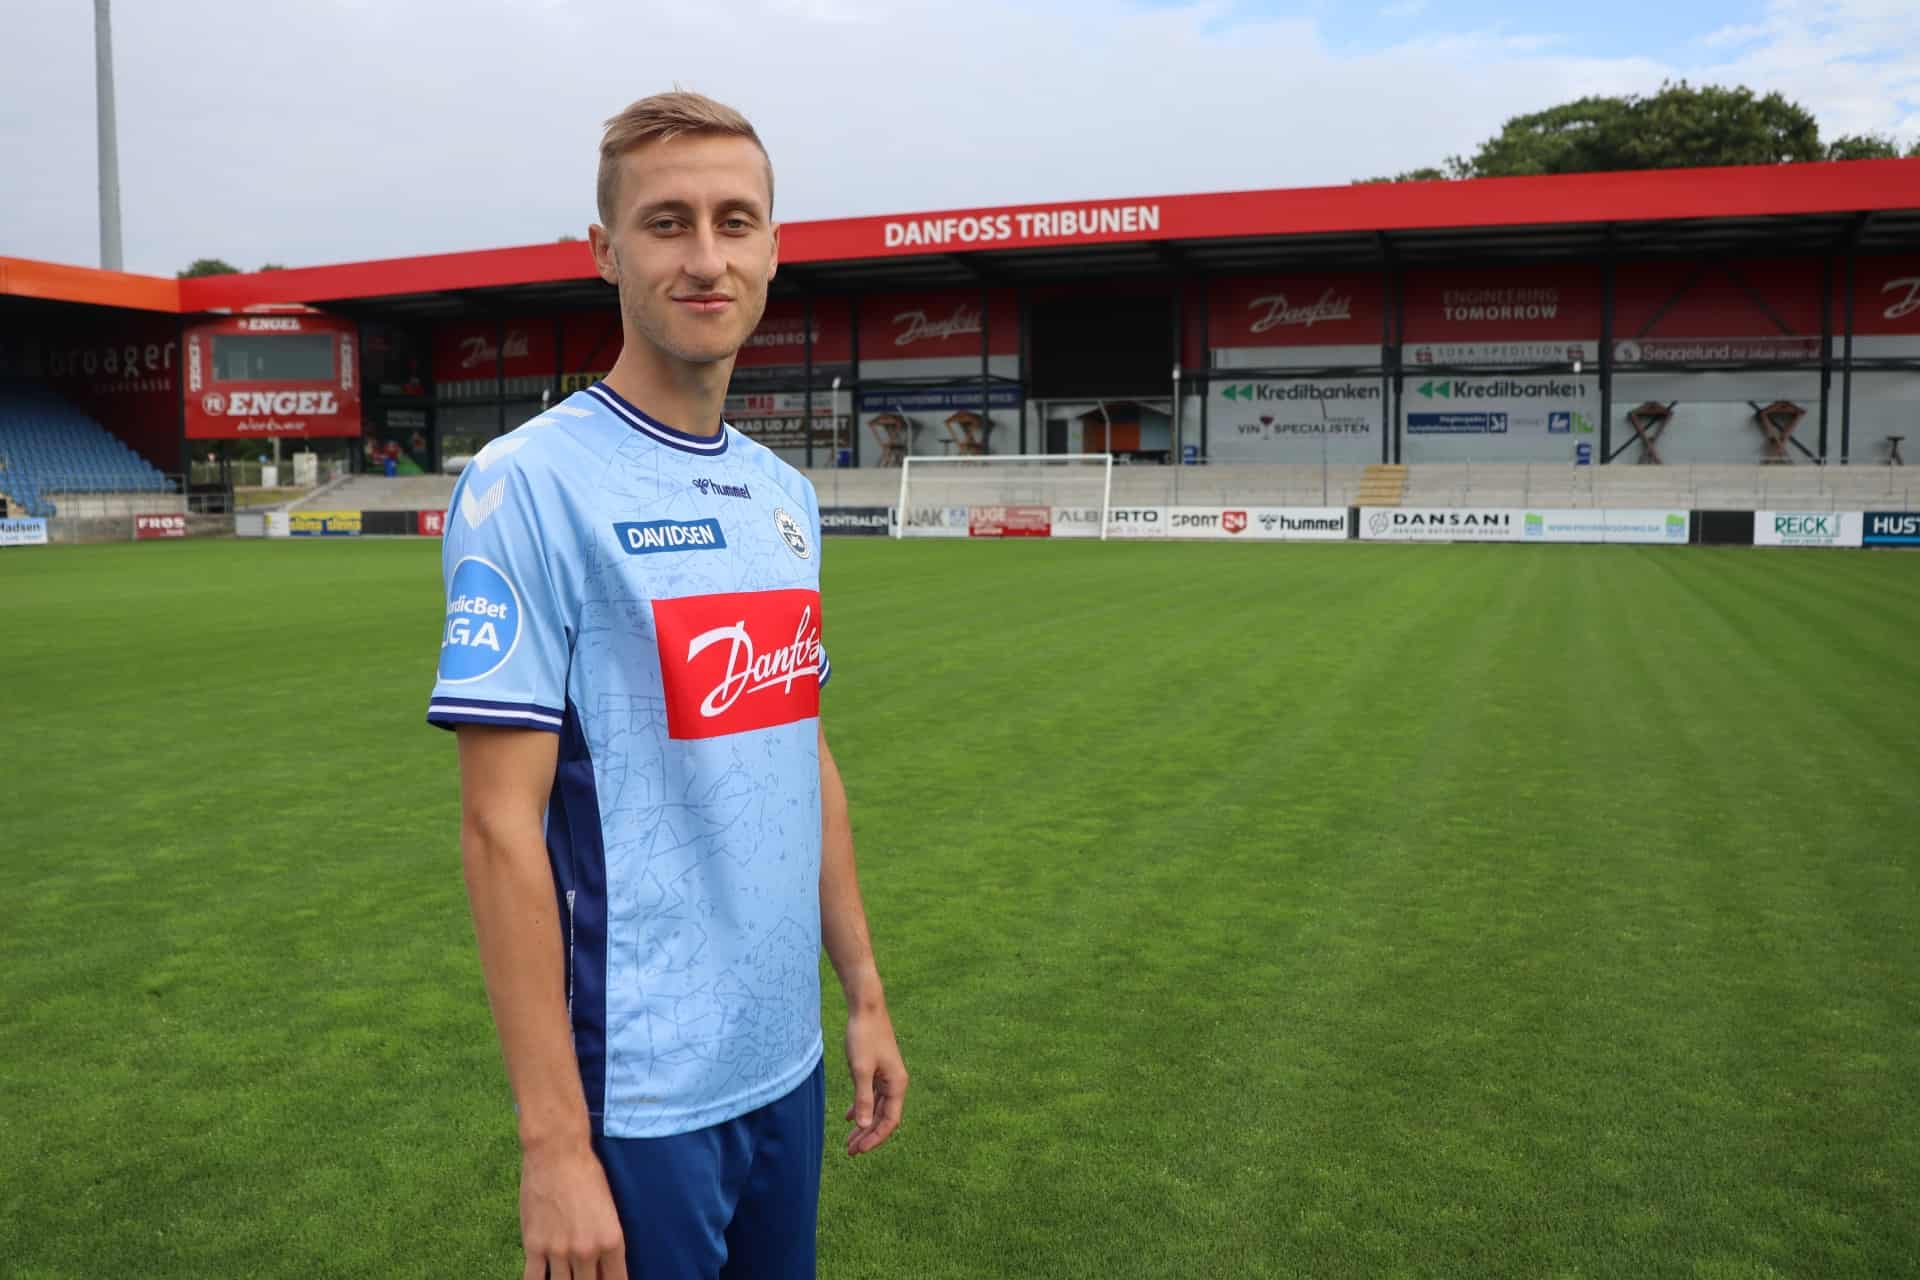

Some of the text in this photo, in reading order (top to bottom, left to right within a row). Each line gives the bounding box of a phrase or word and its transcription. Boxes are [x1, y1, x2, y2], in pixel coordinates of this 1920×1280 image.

[885, 205, 1160, 247] DANFOSS TRIBUNEN
[1442, 304, 1558, 320] TOMORROW
[248, 317, 301, 331] ENGEL
[1256, 383, 1380, 400] Kreditbanken
[1453, 379, 1585, 399] Kreditbanken
[227, 392, 338, 416] ENGEL
[1238, 423, 1370, 433] VIN SPECIALISTEN
[710, 480, 752, 499] hummel
[0, 520, 40, 533] adsen
[1172, 514, 1220, 527] SPORT
[1280, 515, 1344, 531] hummel
[1393, 513, 1510, 525] DANSANI
[627, 524, 716, 548] DAVIDSEN
[442, 618, 500, 651] IGA
